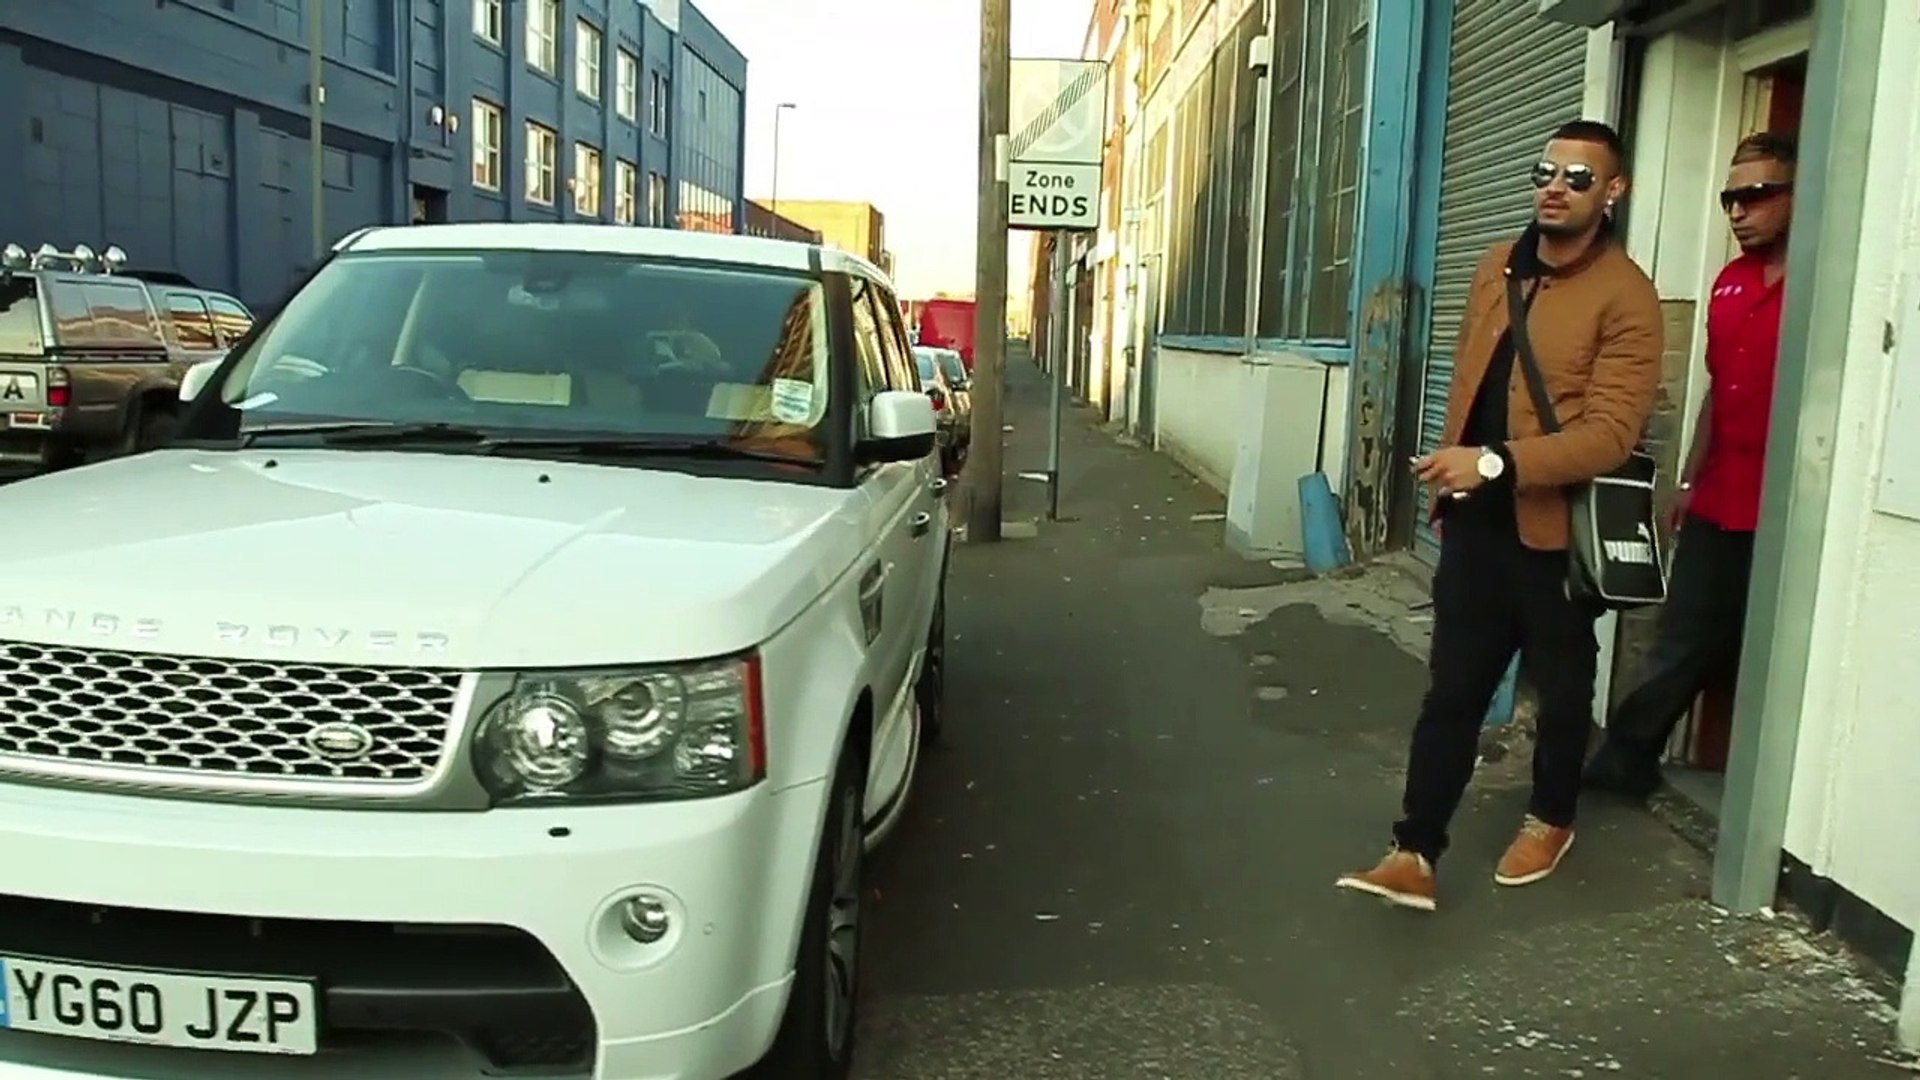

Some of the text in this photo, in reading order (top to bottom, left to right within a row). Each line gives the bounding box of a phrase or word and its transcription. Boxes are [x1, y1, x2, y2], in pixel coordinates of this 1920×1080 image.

[1026, 171, 1075, 188] Zone
[1011, 194, 1088, 216] ENDS
[4, 375, 24, 399] A
[1603, 541, 1653, 564] PUMA
[215, 621, 449, 651] ROVER
[13, 967, 300, 1043] YG60 JZP
